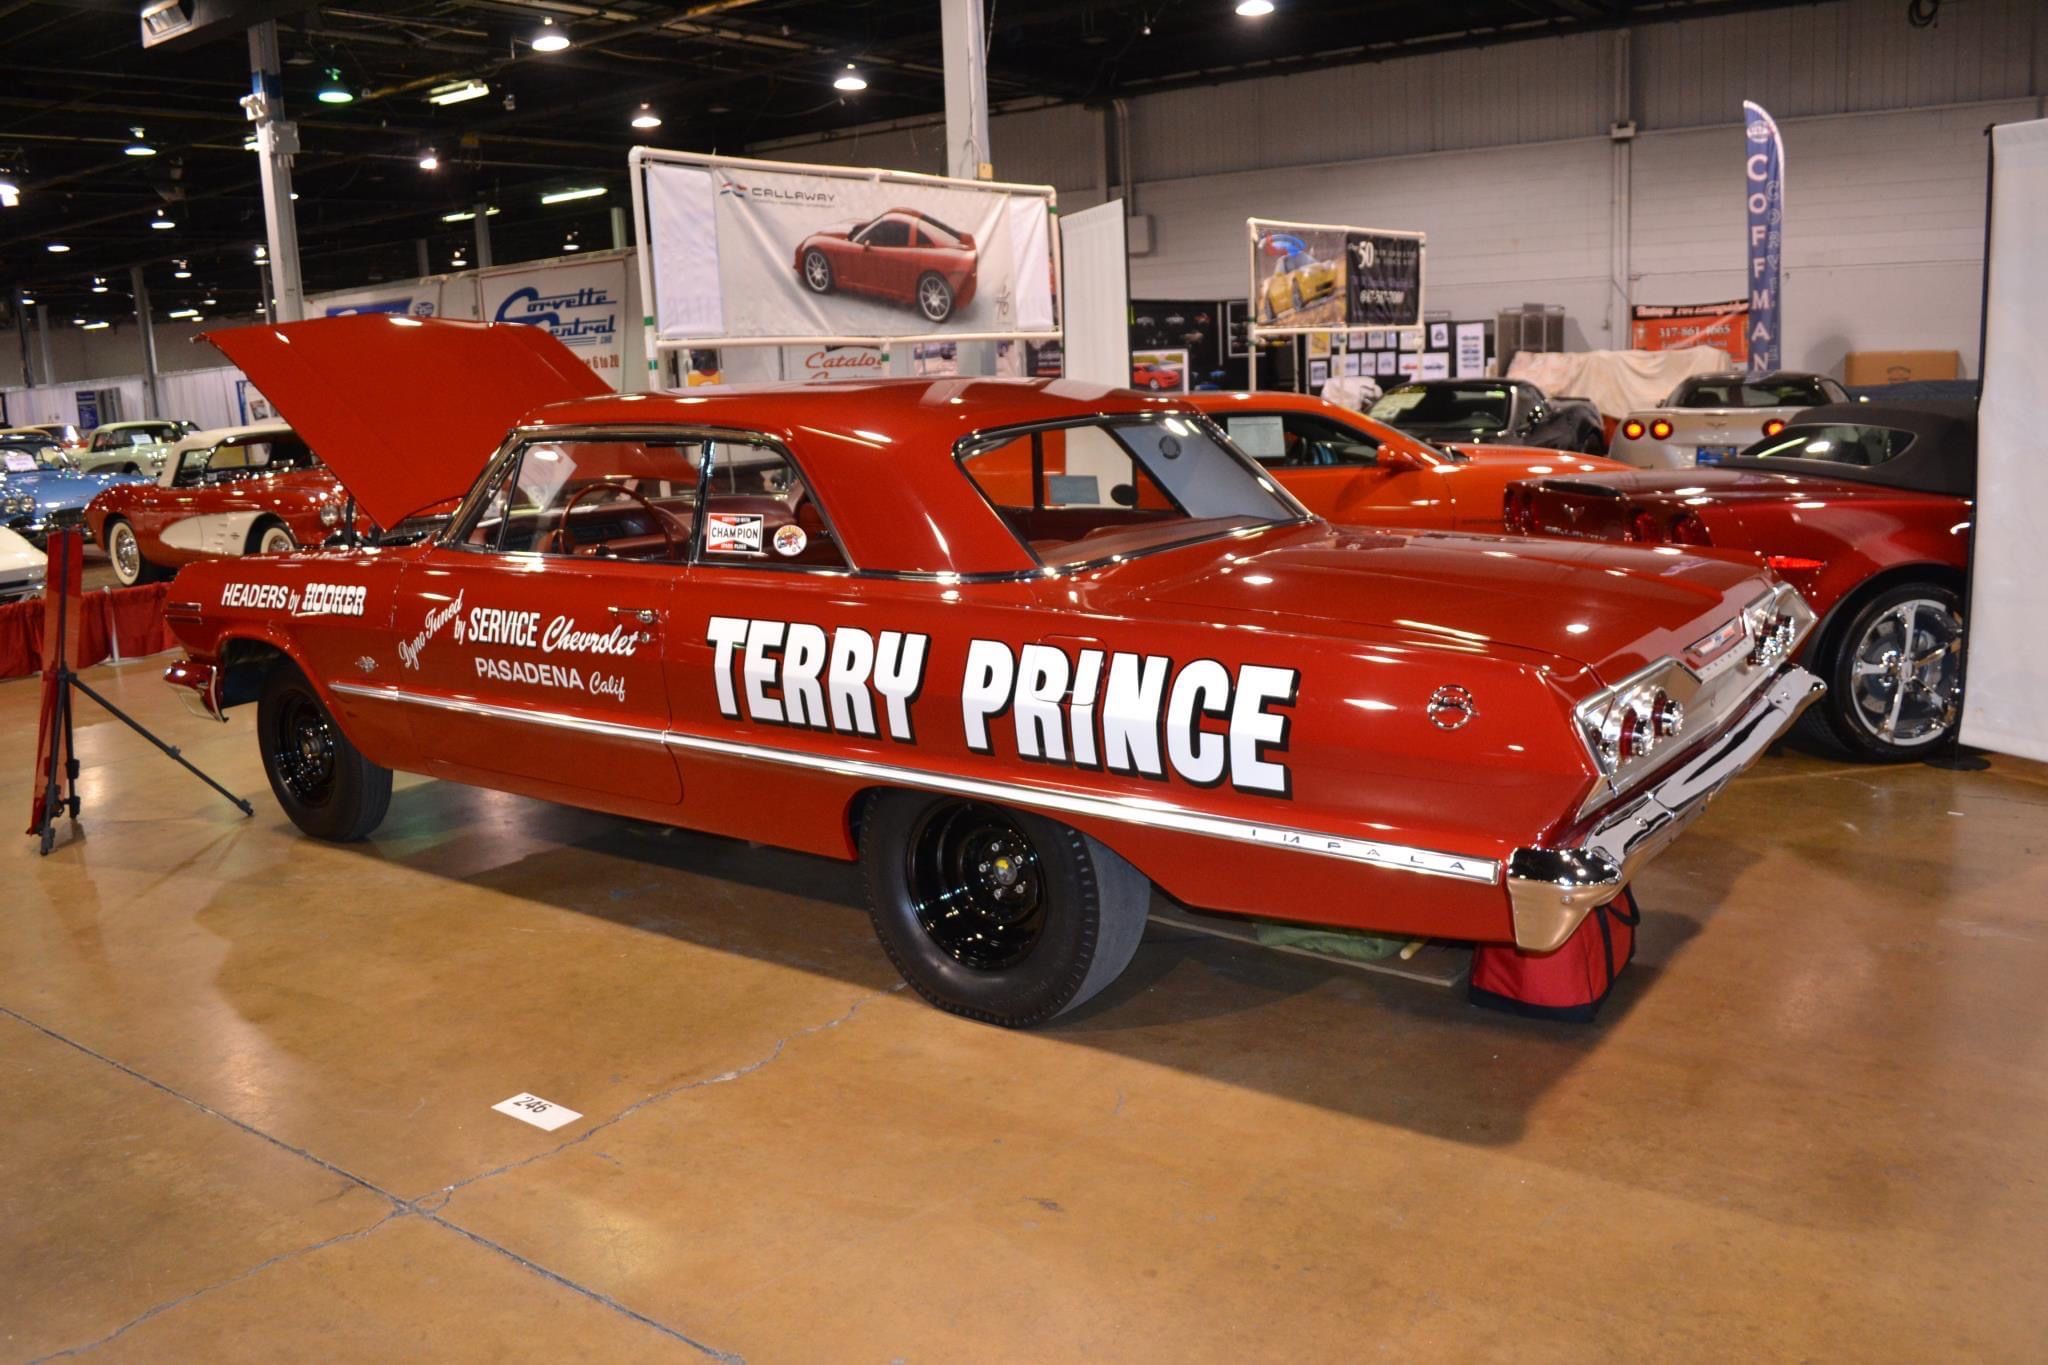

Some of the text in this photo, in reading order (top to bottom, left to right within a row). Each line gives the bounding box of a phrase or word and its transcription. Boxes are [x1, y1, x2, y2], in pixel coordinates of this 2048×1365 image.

[751, 187, 836, 202] CALLAWAY
[1358, 240, 1375, 269] 50
[1747, 153, 1770, 372] COFFMAN
[494, 286, 611, 322] Corvette
[711, 527, 759, 539] CHAMPION
[221, 583, 367, 616] HEADERS by HOOKER
[398, 588, 640, 671] Dyno Tuned by SERVICE Chevrolet
[474, 657, 626, 702] PASADENA Calif
[706, 615, 1299, 799] TERRY PRINCE
[1252, 828, 1466, 871] IMPALA
[512, 1095, 553, 1114] 246
